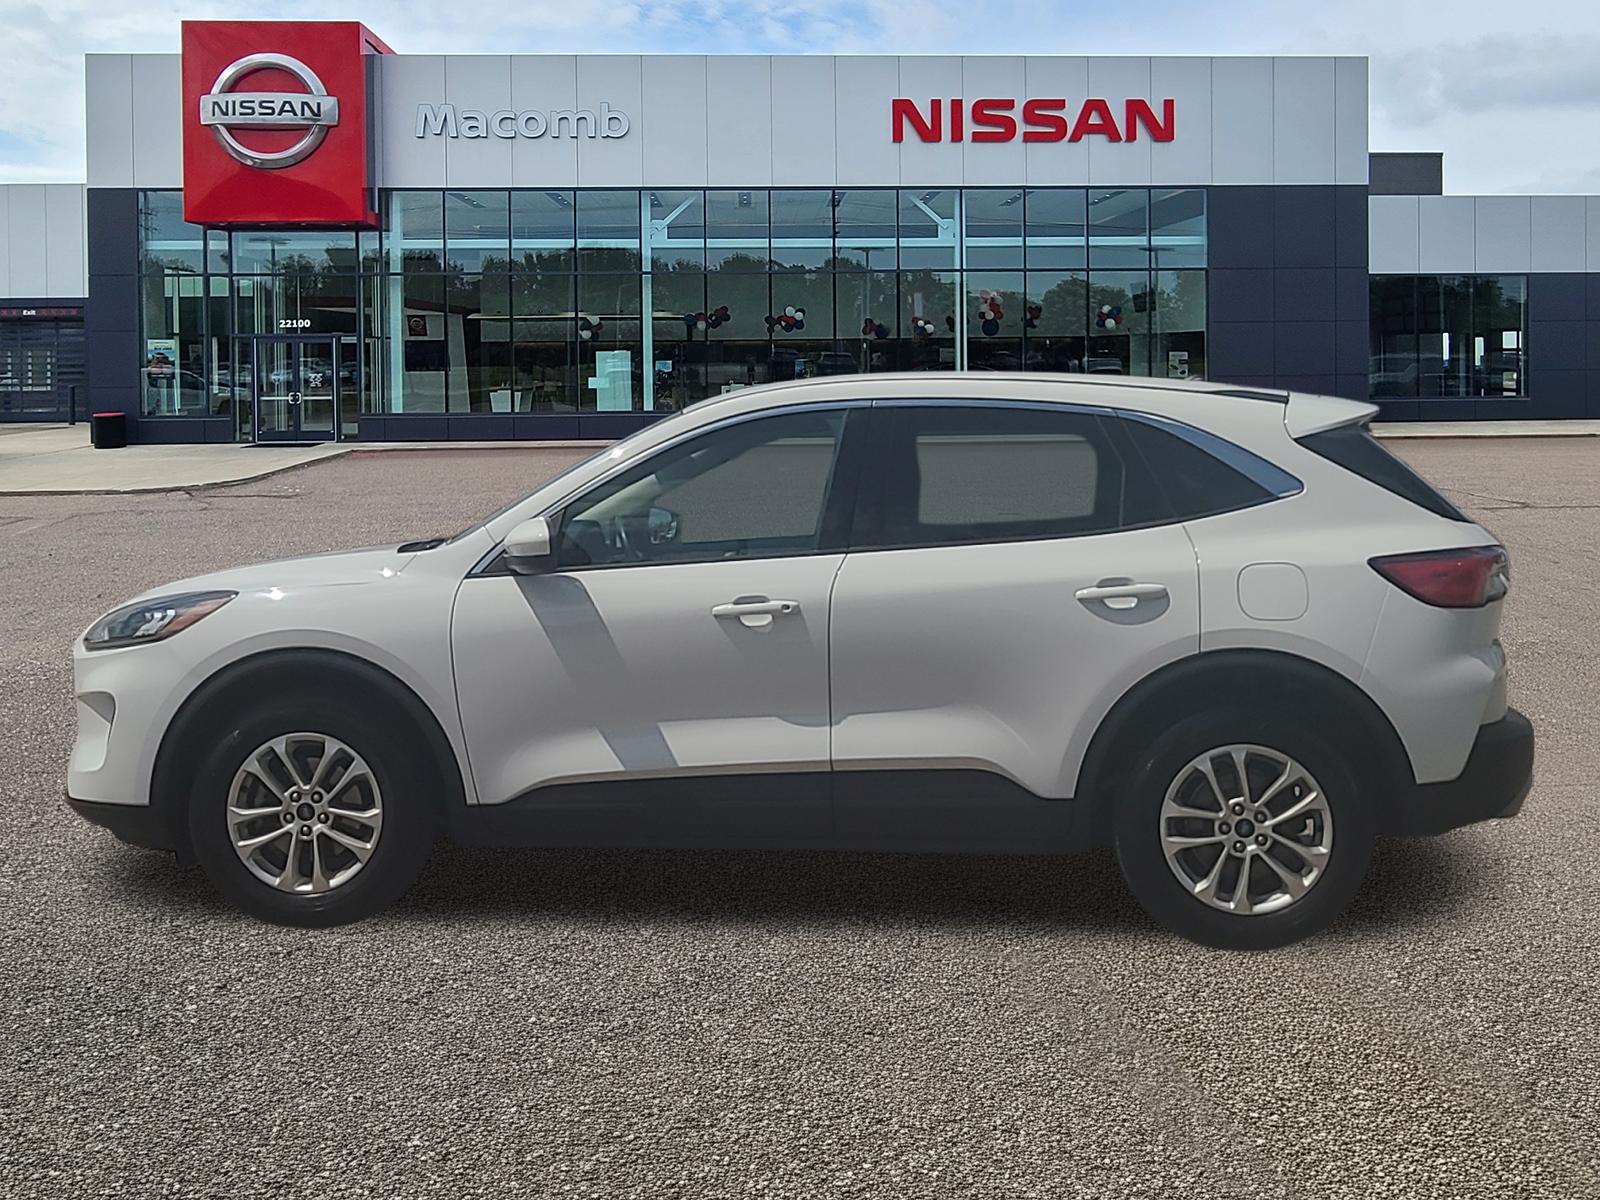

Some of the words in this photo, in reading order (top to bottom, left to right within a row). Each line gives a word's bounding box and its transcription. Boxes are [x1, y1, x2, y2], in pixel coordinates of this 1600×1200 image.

[211, 100, 322, 117] NISSAN
[415, 101, 630, 139] Macomb
[892, 98, 1175, 143] NISSAN
[279, 319, 311, 328] 22100
